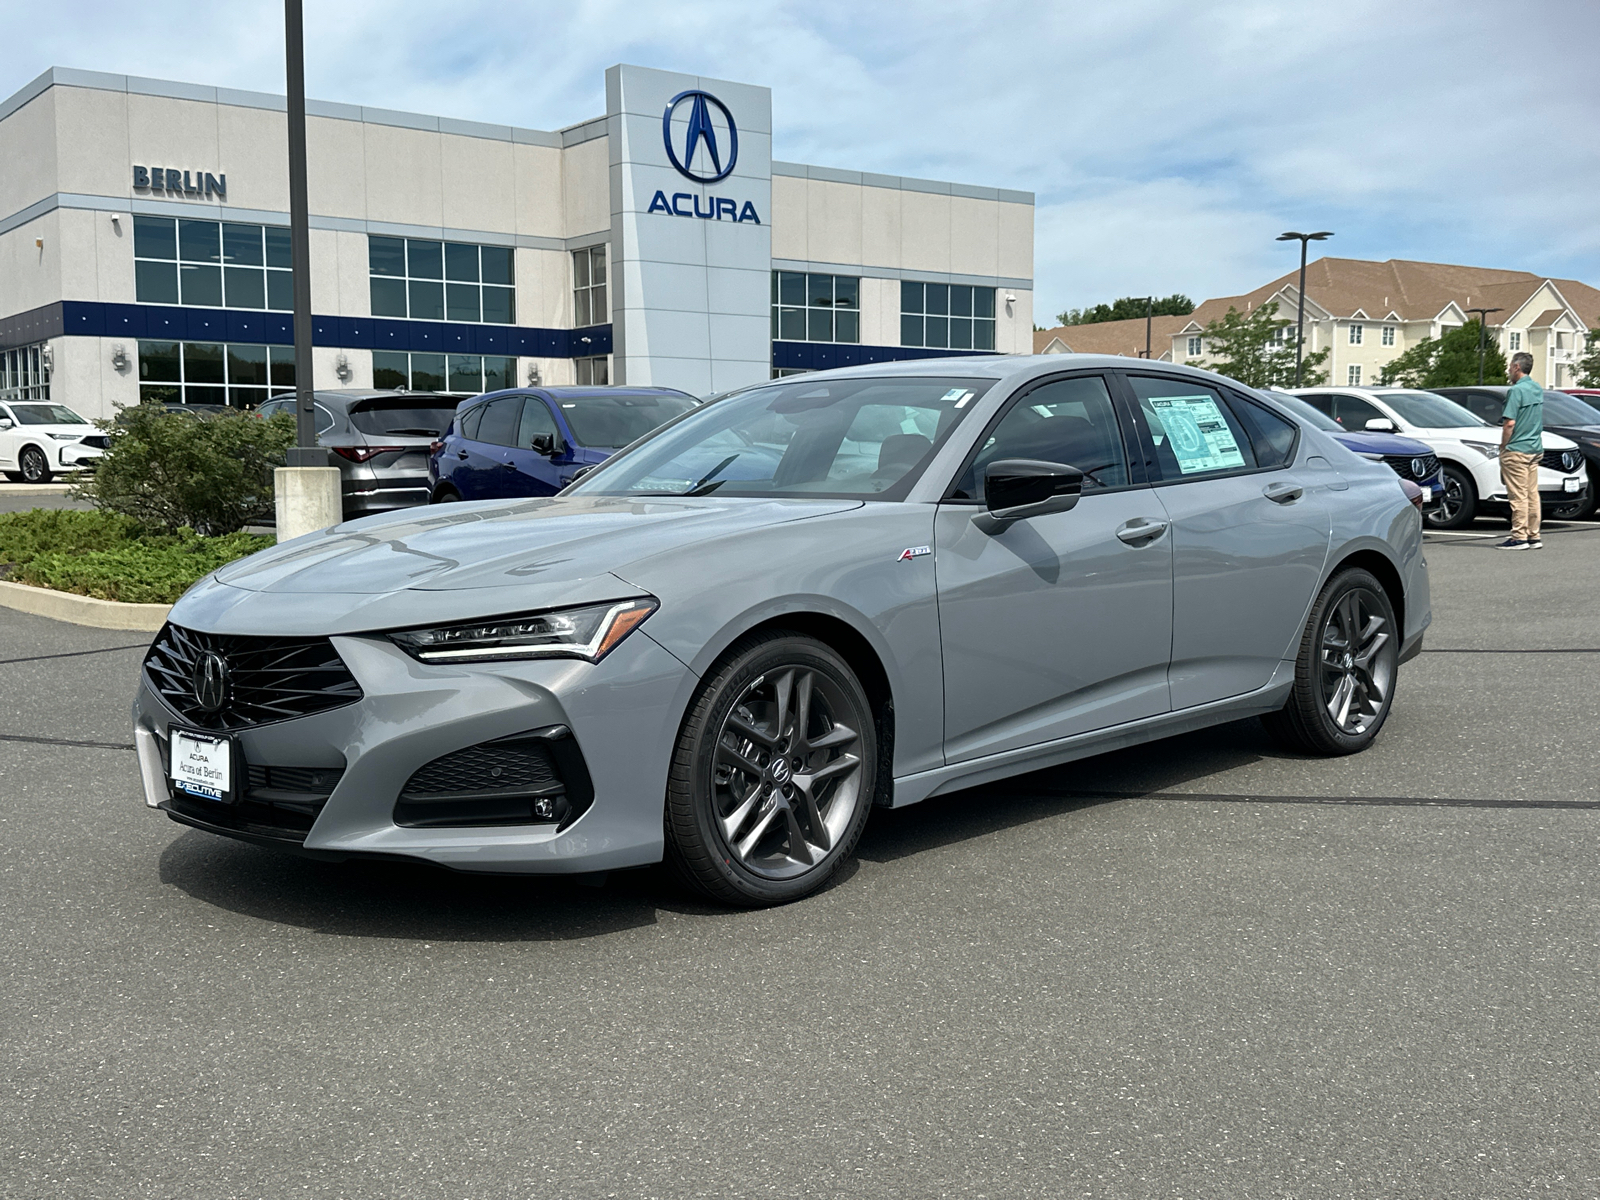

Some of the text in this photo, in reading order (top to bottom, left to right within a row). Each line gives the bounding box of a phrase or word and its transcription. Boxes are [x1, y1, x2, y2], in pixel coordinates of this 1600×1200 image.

[133, 165, 226, 196] BERLIN
[647, 190, 761, 224] ACURA
[189, 753, 209, 763] ACURA
[180, 761, 223, 780] Acura of Berlin
[175, 780, 222, 797] EXECUTIVE
